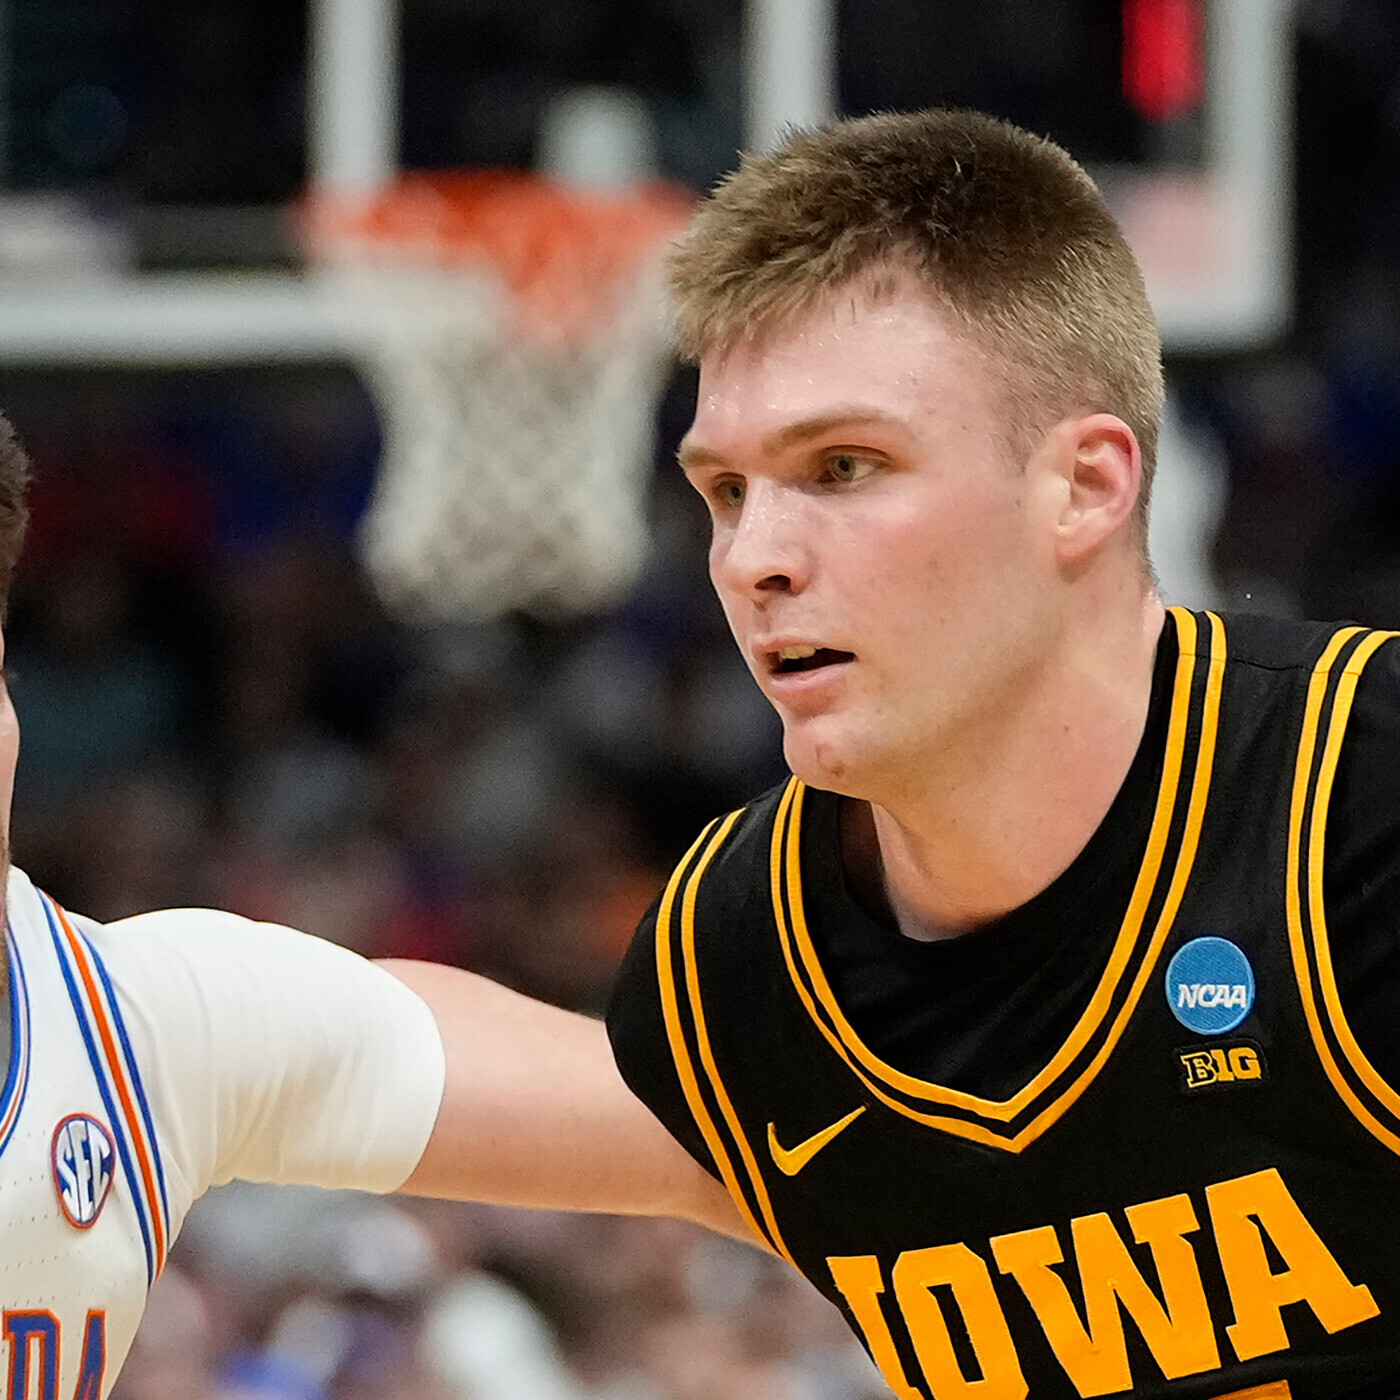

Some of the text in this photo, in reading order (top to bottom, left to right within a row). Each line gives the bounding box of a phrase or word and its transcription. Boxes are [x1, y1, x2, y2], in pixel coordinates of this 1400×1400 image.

[1177, 983, 1247, 1009] NCAA
[1180, 1047, 1262, 1088] BIG
[56, 1120, 111, 1222] SEC
